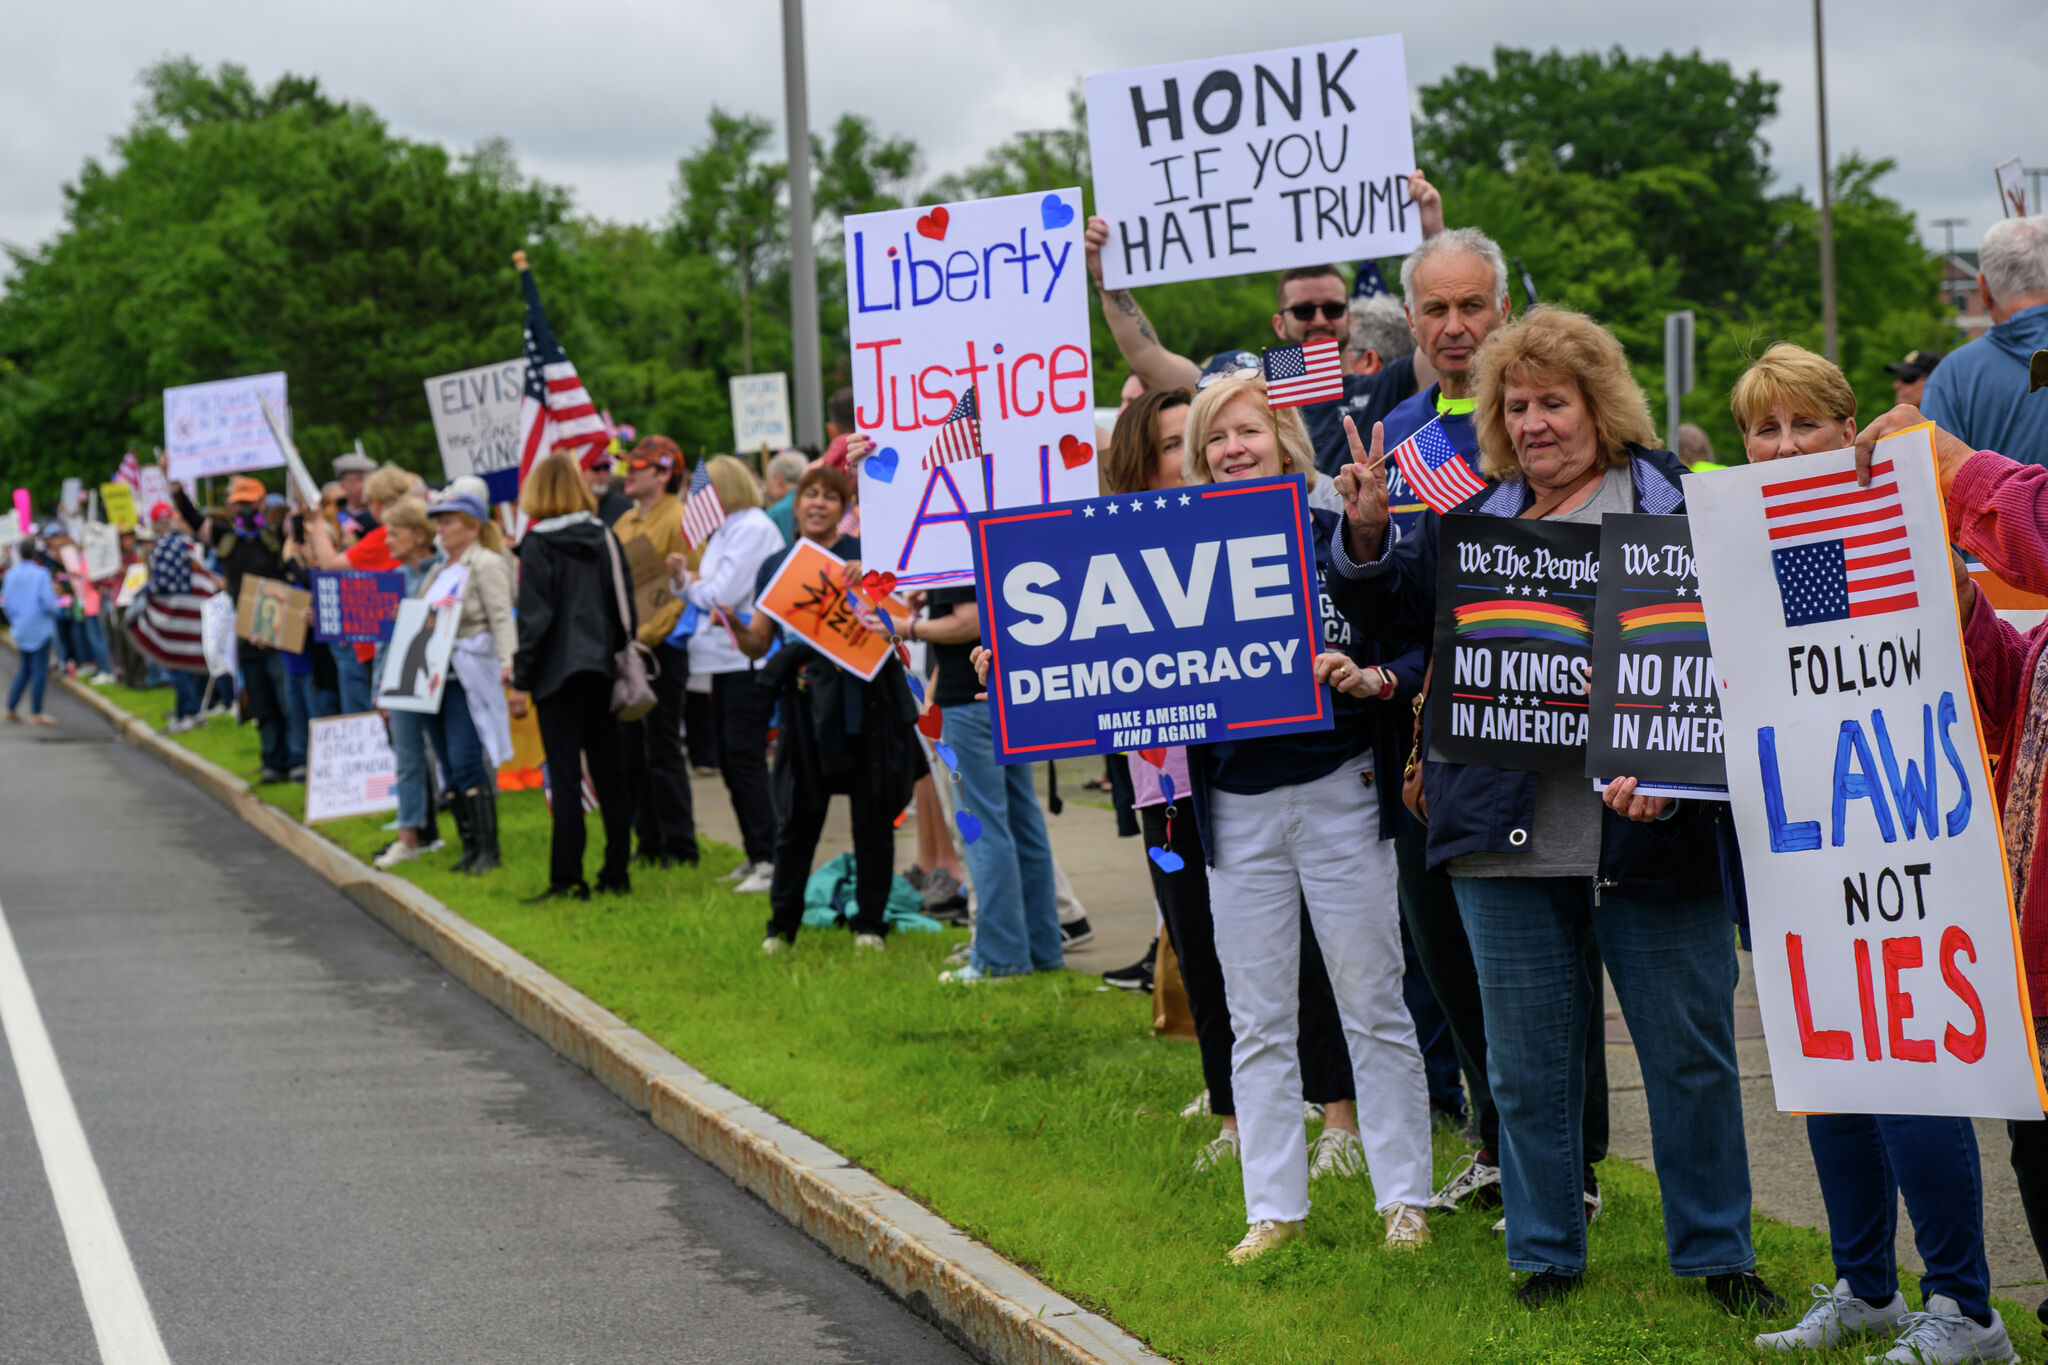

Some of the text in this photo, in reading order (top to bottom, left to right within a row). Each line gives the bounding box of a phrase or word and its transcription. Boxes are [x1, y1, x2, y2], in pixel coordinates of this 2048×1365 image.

[1129, 48, 1359, 148] HONK
[1150, 124, 1348, 206] IF YOU
[1118, 174, 1414, 275] HATE TRUMP
[854, 226, 1073, 315] Liberty
[441, 366, 520, 416] ELVIS
[856, 338, 1089, 432] Justice
[317, 577, 339, 591] NO
[1457, 541, 1599, 589] We The People
[1621, 543, 1660, 576] We
[318, 592, 339, 605] NO
[320, 606, 340, 619] NO
[1002, 532, 1296, 647] SAVE
[320, 621, 341, 635] NO
[1008, 638, 1301, 705] DEMOCRACY
[1454, 646, 1588, 696] NO KINGS
[1617, 653, 1662, 697] NO
[1789, 629, 1921, 695] FOLLOW
[1097, 702, 1217, 731] MAKE AMERICA
[1113, 722, 1207, 748] KIND AGAIN
[1452, 702, 1589, 746] IN AMERICA
[1612, 713, 1640, 750] IN
[1758, 692, 1972, 852] LAWS
[1843, 864, 1931, 925] NOT
[1786, 926, 1987, 1063] LIES
